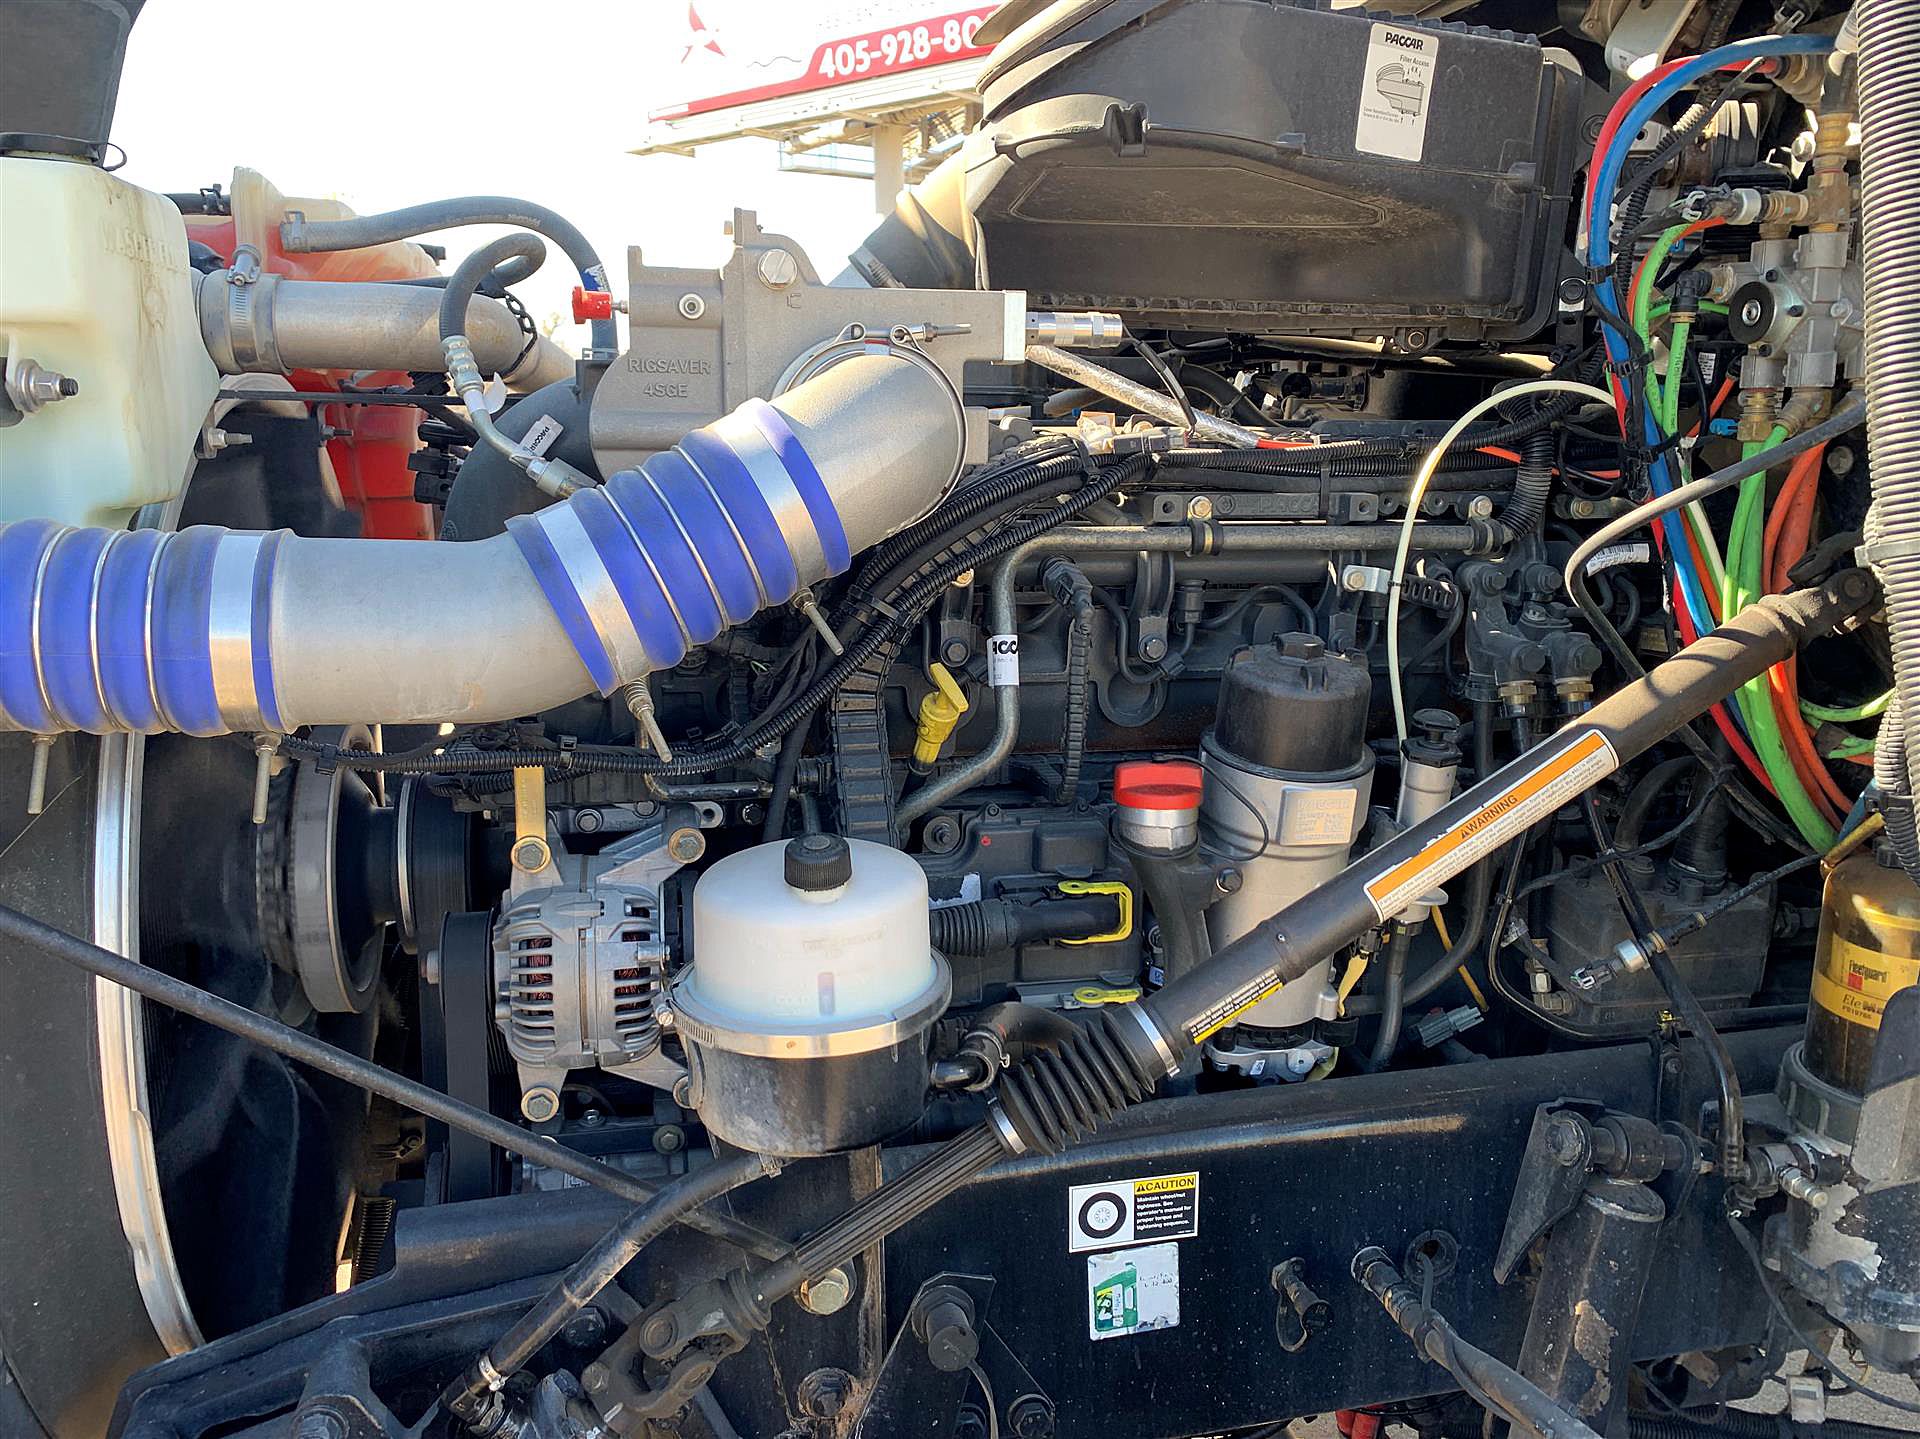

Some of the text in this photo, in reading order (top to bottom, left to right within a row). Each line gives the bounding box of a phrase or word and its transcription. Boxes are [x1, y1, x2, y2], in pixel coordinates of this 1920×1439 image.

[819, 14, 990, 79] 405-928-80
[1385, 32, 1424, 51] PACCAR
[627, 357, 711, 375] RIGSAVER
[643, 383, 689, 398] 4SGE
[1466, 794, 1518, 832] WARNING
[1146, 1178, 1194, 1190] CAUTION
